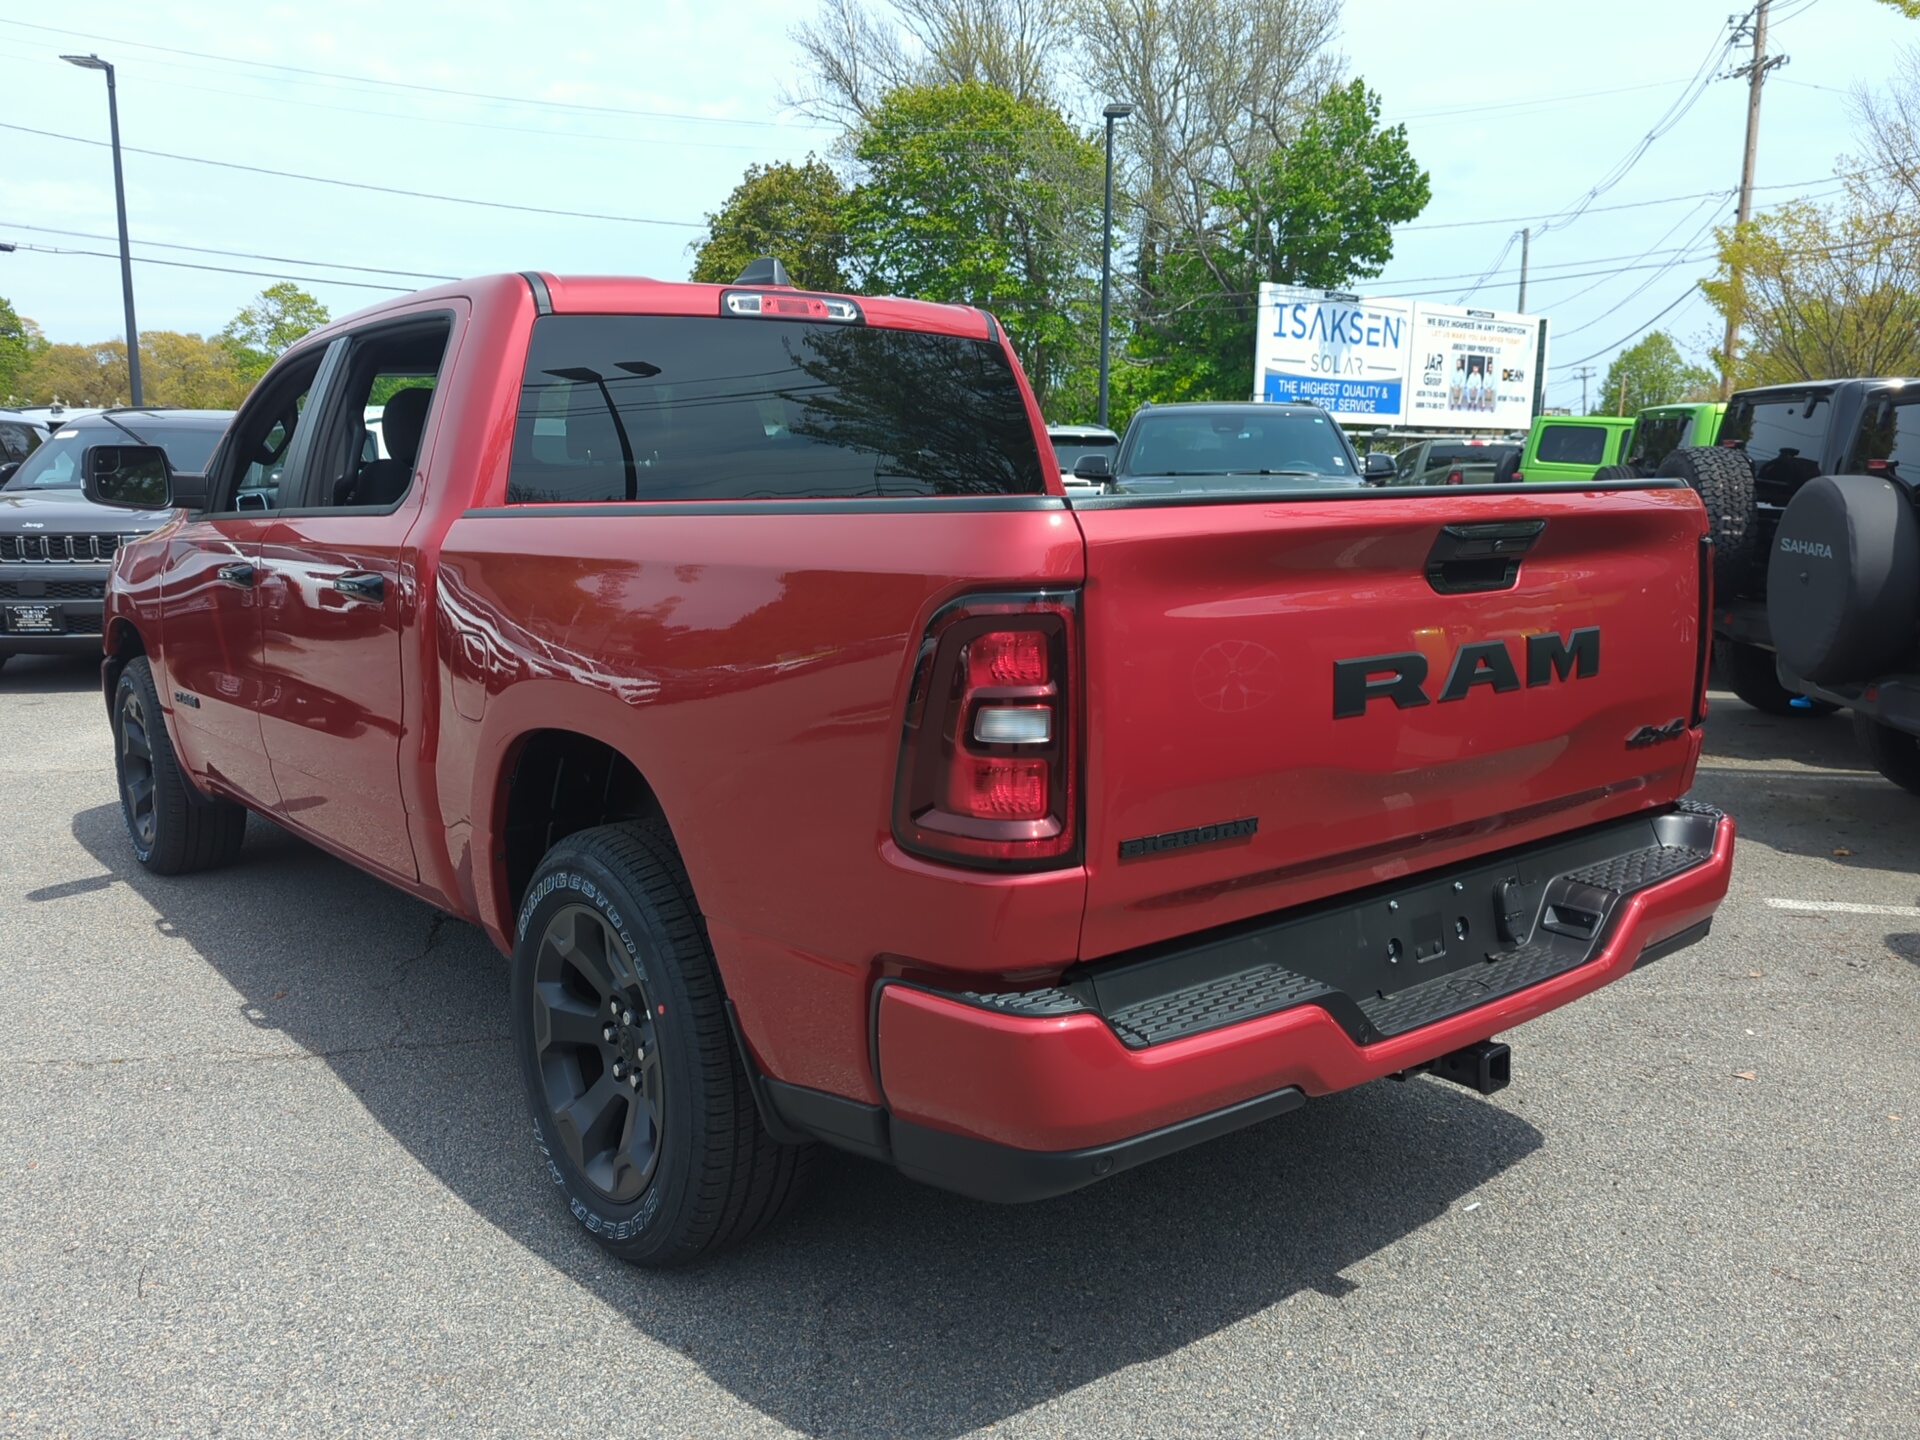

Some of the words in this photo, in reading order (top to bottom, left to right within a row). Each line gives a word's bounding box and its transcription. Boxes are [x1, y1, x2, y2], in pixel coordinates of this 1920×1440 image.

[1273, 302, 1401, 349] ISAKSEN
[1438, 319, 1450, 327] BUY
[1452, 321, 1475, 330] HOUSES
[1497, 326, 1526, 335] CONDITION
[1310, 353, 1363, 375] SOLAR
[1424, 353, 1444, 371] JAR
[1502, 369, 1524, 383] DEAN
[1279, 380, 1297, 393] THE
[1300, 381, 1341, 396] HIGHEST
[1342, 384, 1381, 398] QUALITY
[1382, 387, 1388, 399] &
[1338, 399, 1376, 413] SERVICE
[1780, 537, 1833, 559] SAHARA
[1332, 626, 1600, 719] RAM
[518, 872, 649, 982] BRIDGESTONE
